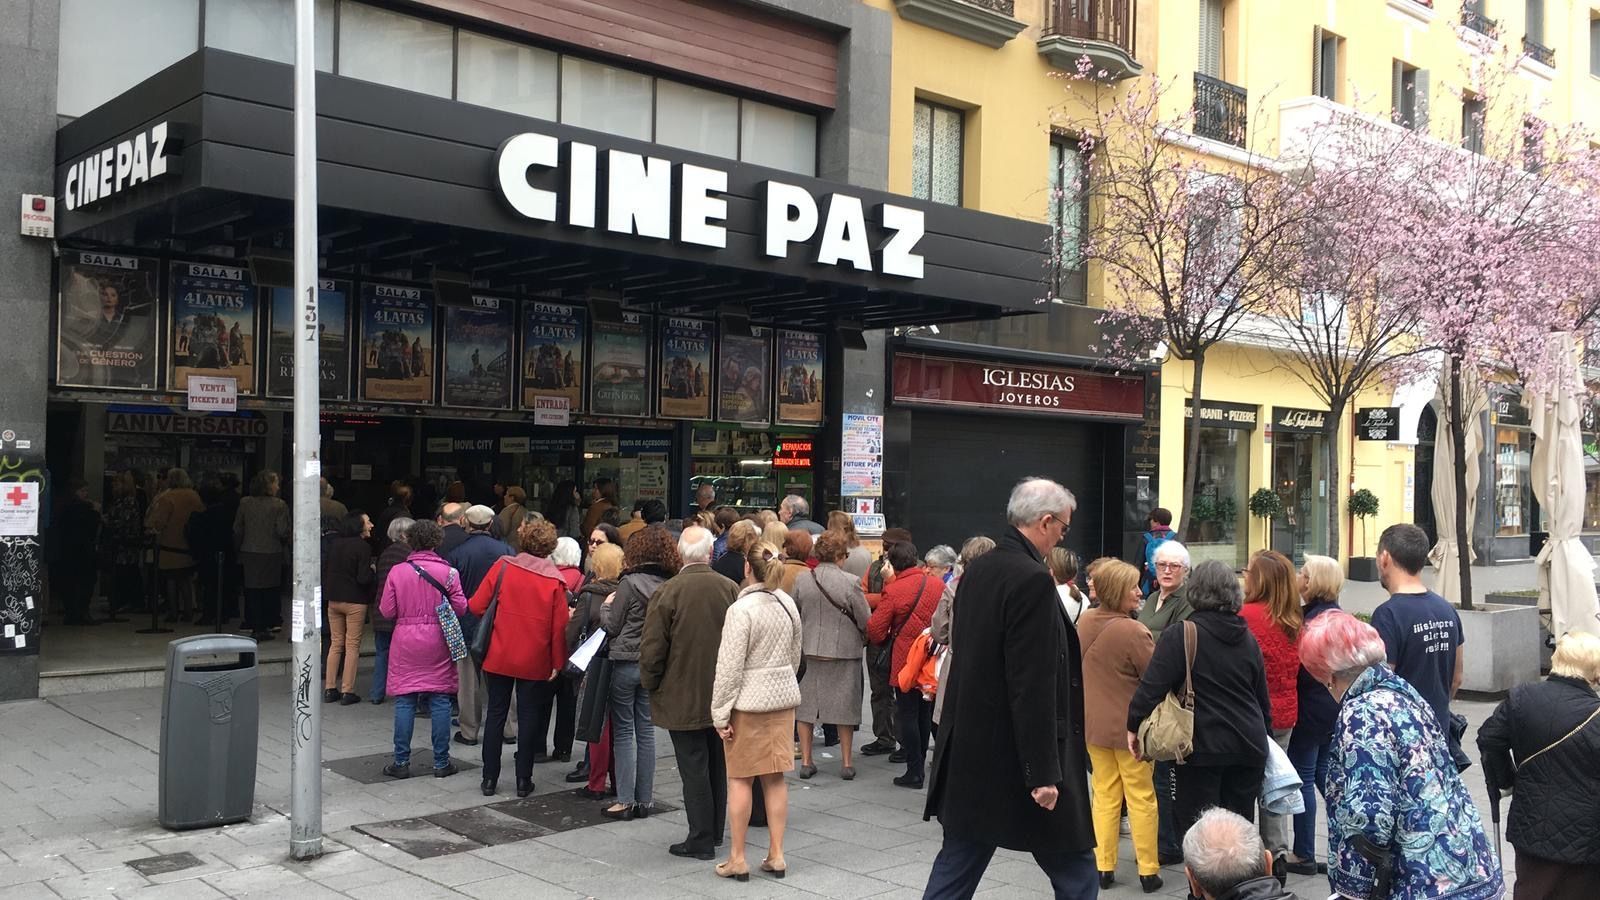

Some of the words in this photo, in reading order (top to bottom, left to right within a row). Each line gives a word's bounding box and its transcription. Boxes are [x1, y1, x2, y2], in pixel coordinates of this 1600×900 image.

[65, 147, 113, 210] CINE
[116, 121, 167, 192] PAZ
[497, 132, 728, 249] CINE
[764, 180, 925, 279] PAZ
[84, 254, 122, 267] SALA
[129, 260, 136, 268] 1
[192, 266, 228, 278] SALA
[233, 271, 239, 279] 1
[326, 281, 333, 290] 2
[377, 287, 407, 297] SALA
[412, 291, 418, 299] 2
[492, 299, 498, 308] 3
[535, 304, 560, 314] SALA
[304, 286, 316, 341] 137
[670, 320, 693, 329] SALA
[983, 368, 1075, 392] IGLESIAS
[200, 383, 226, 392] VENTA
[190, 396, 219, 404] TICKETS
[536, 399, 568, 409] ENTRADA
[999, 392, 1060, 406] JOYEROS
[1229, 410, 1256, 422] PIZZERIE
[112, 414, 268, 435] ANIVERSARIO
[454, 439, 475, 450] MOVIL
[477, 440, 493, 450] CITY
